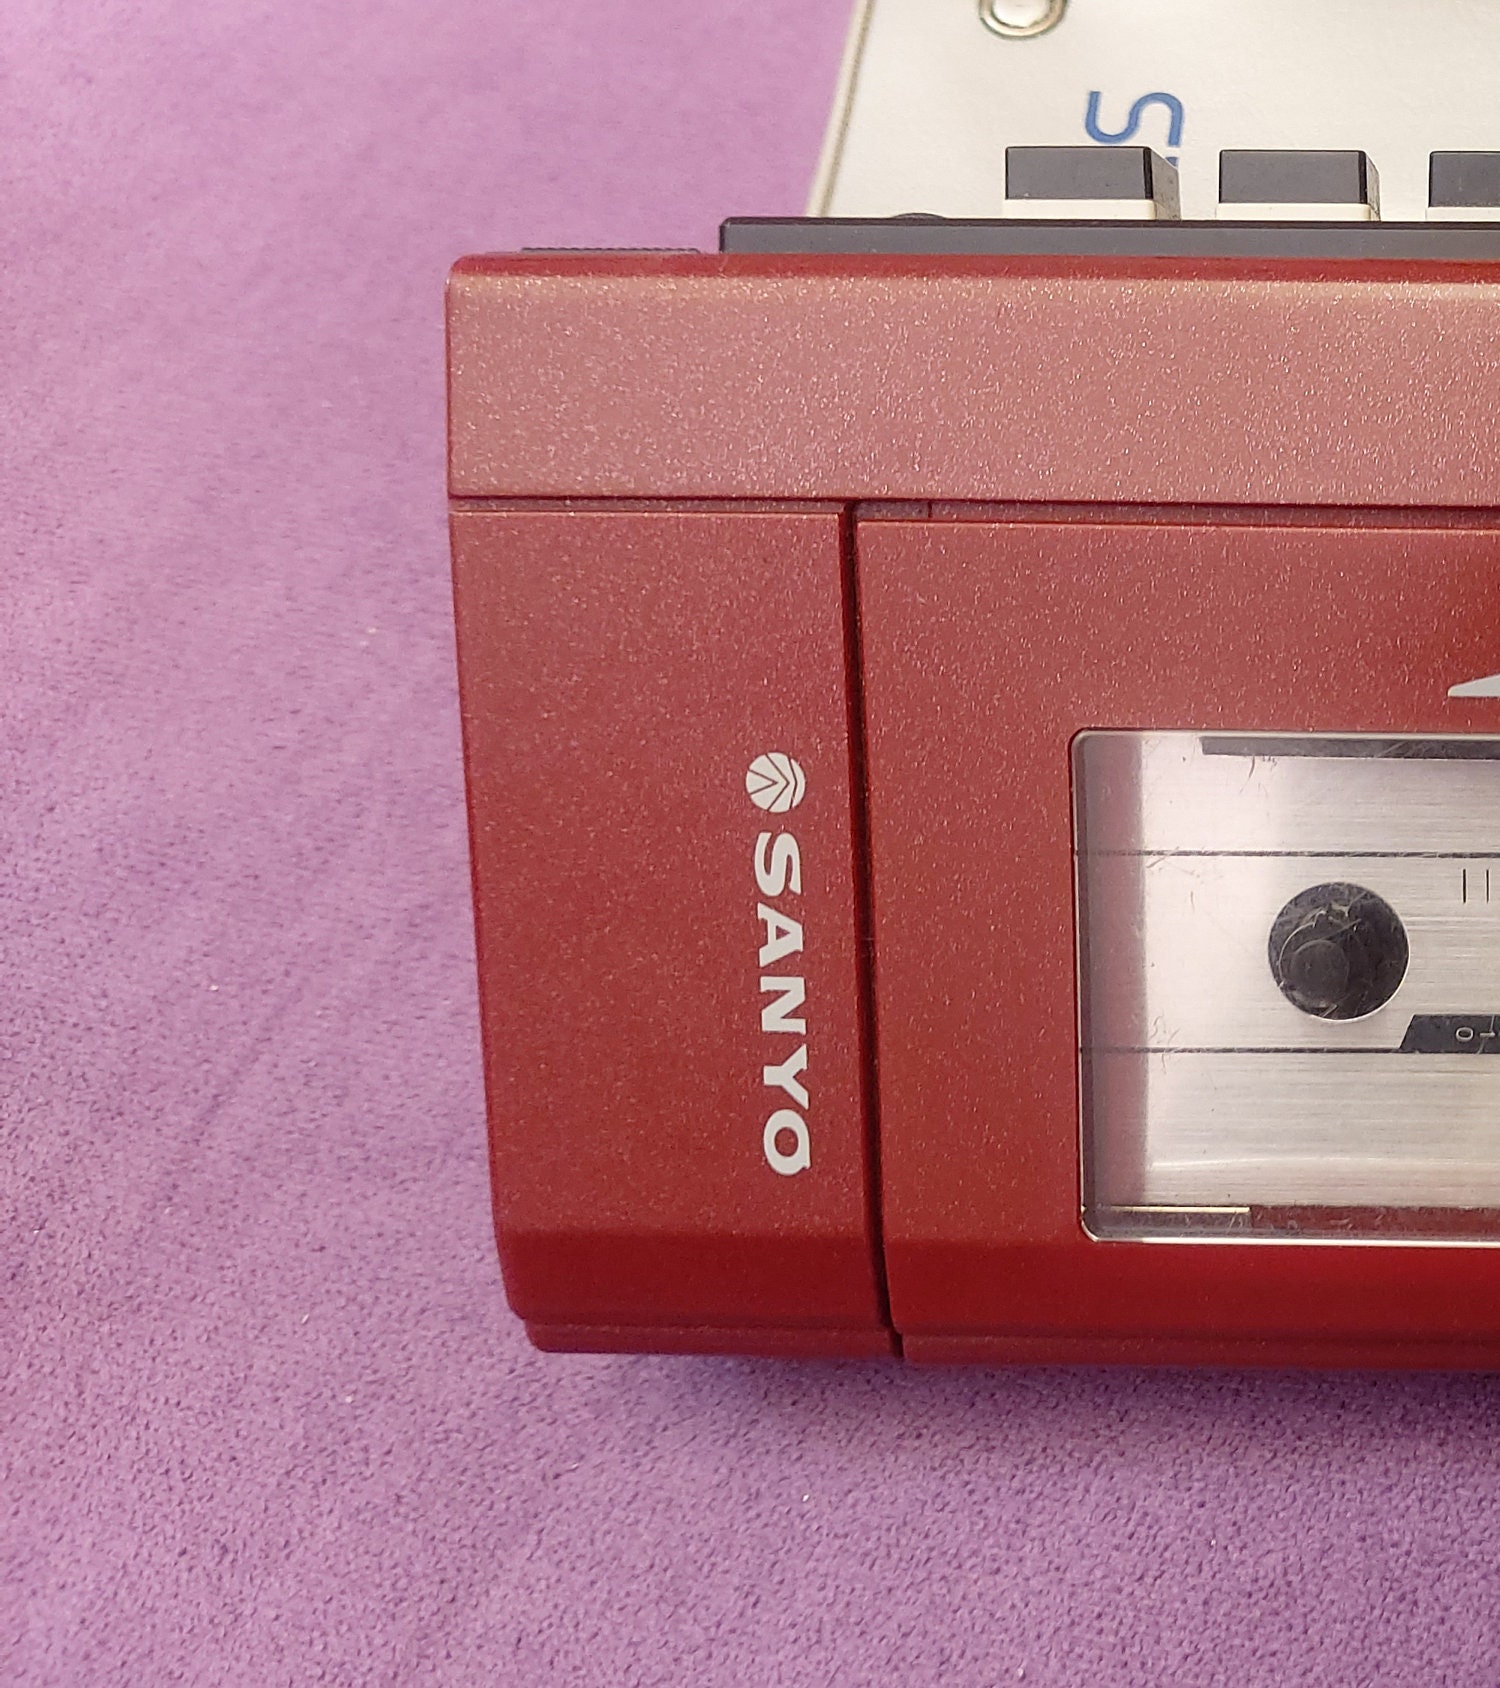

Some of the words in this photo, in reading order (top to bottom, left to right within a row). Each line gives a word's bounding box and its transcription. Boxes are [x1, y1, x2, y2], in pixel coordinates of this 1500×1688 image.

[754, 831, 812, 1176] SANYO
[1455, 1027, 1474, 1042] 0
[1479, 1030, 1496, 1039] 1
